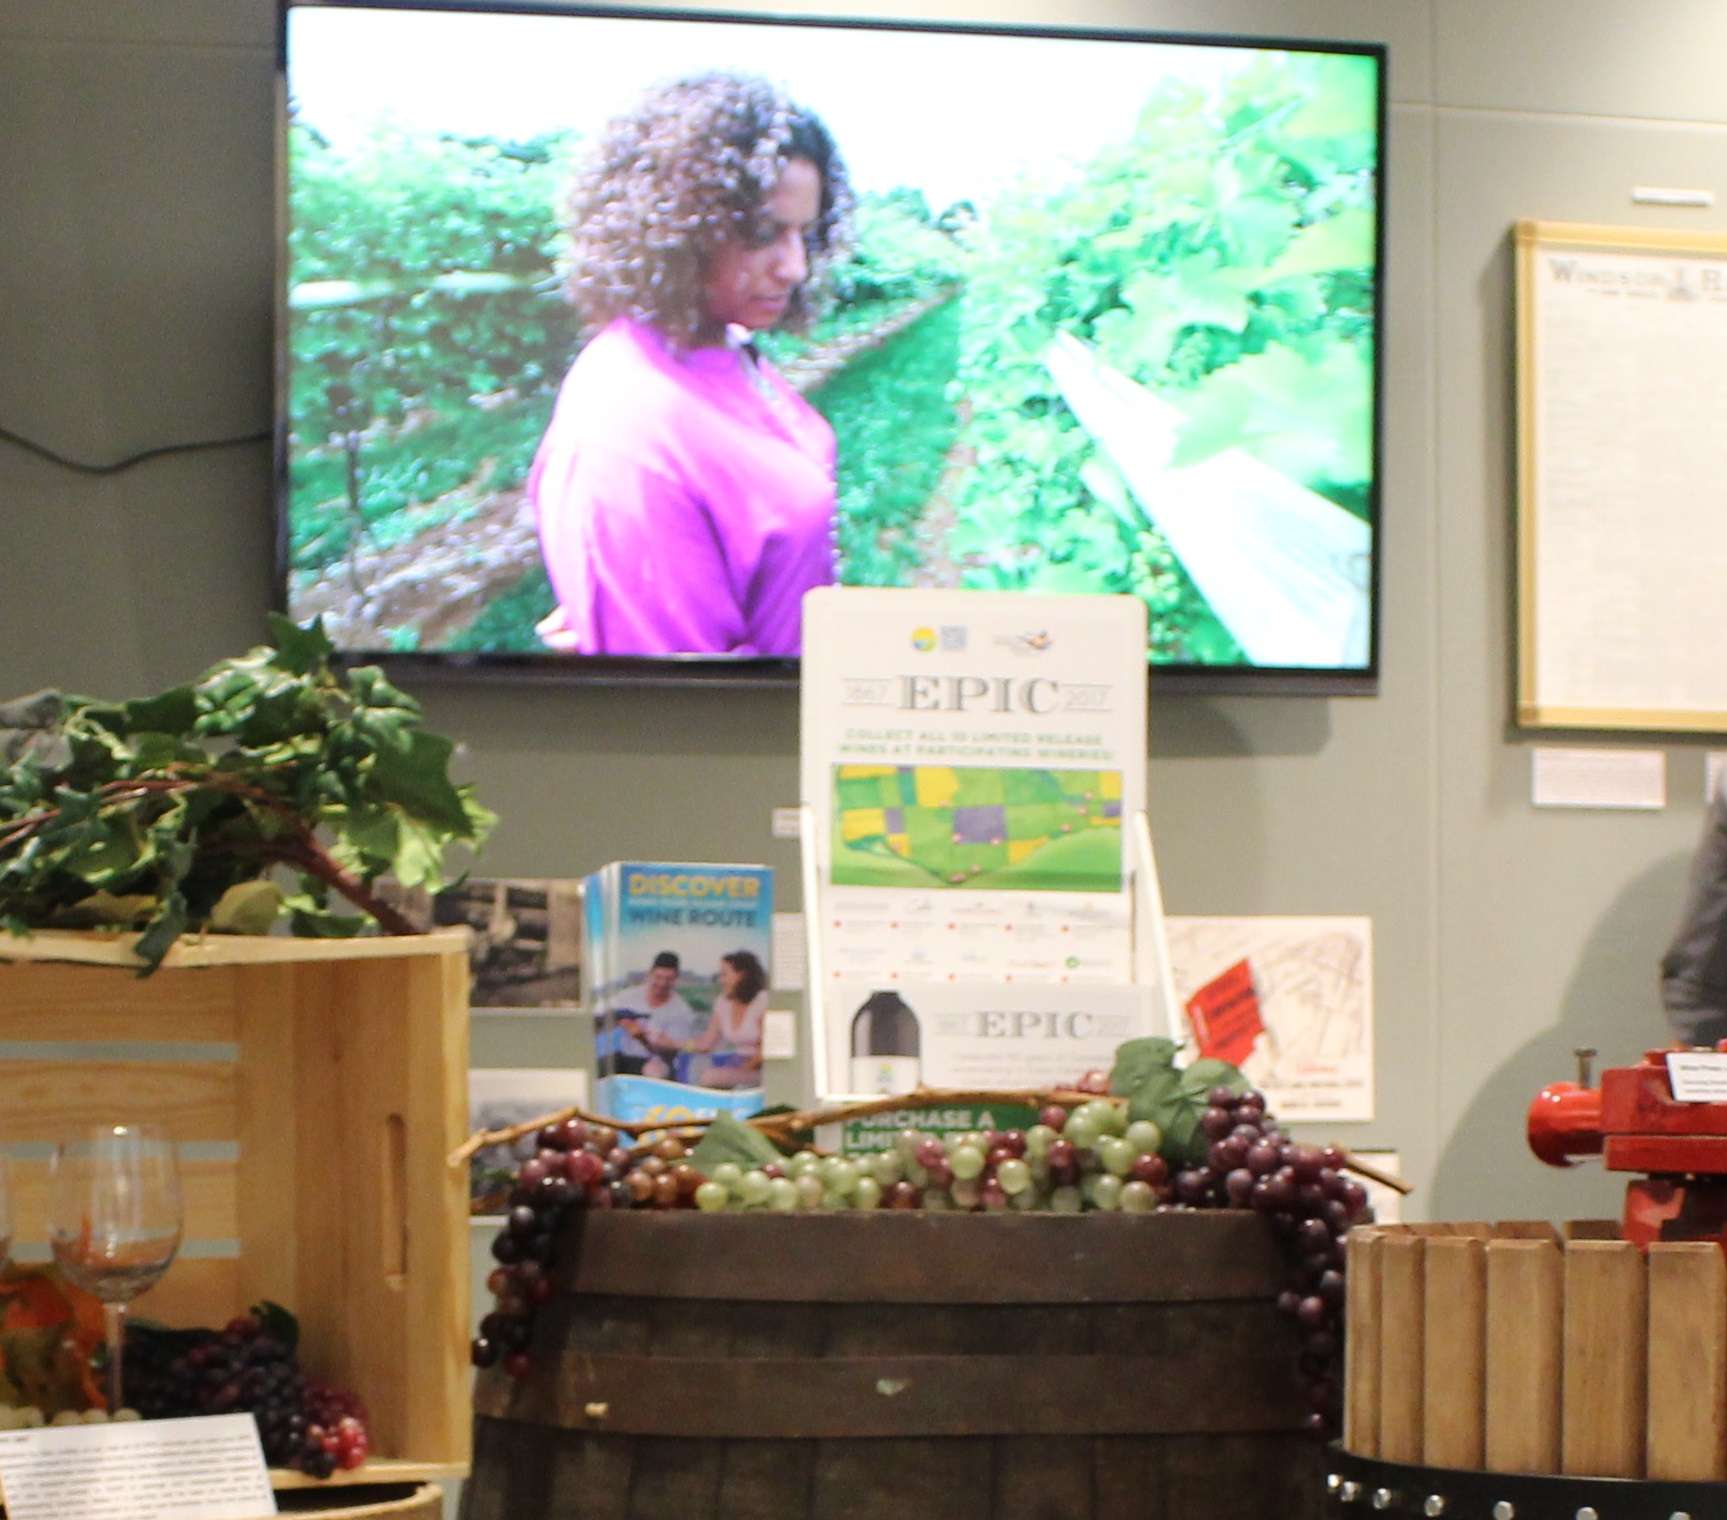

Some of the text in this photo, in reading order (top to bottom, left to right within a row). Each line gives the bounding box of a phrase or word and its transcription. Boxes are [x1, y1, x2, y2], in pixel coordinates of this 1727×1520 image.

[896, 675, 1059, 714] EPIC
[628, 874, 760, 897] DISCOVER
[630, 907, 757, 928] WINE ROUTE
[976, 1010, 1093, 1039] EPIC
[976, 1111, 995, 1129] A
